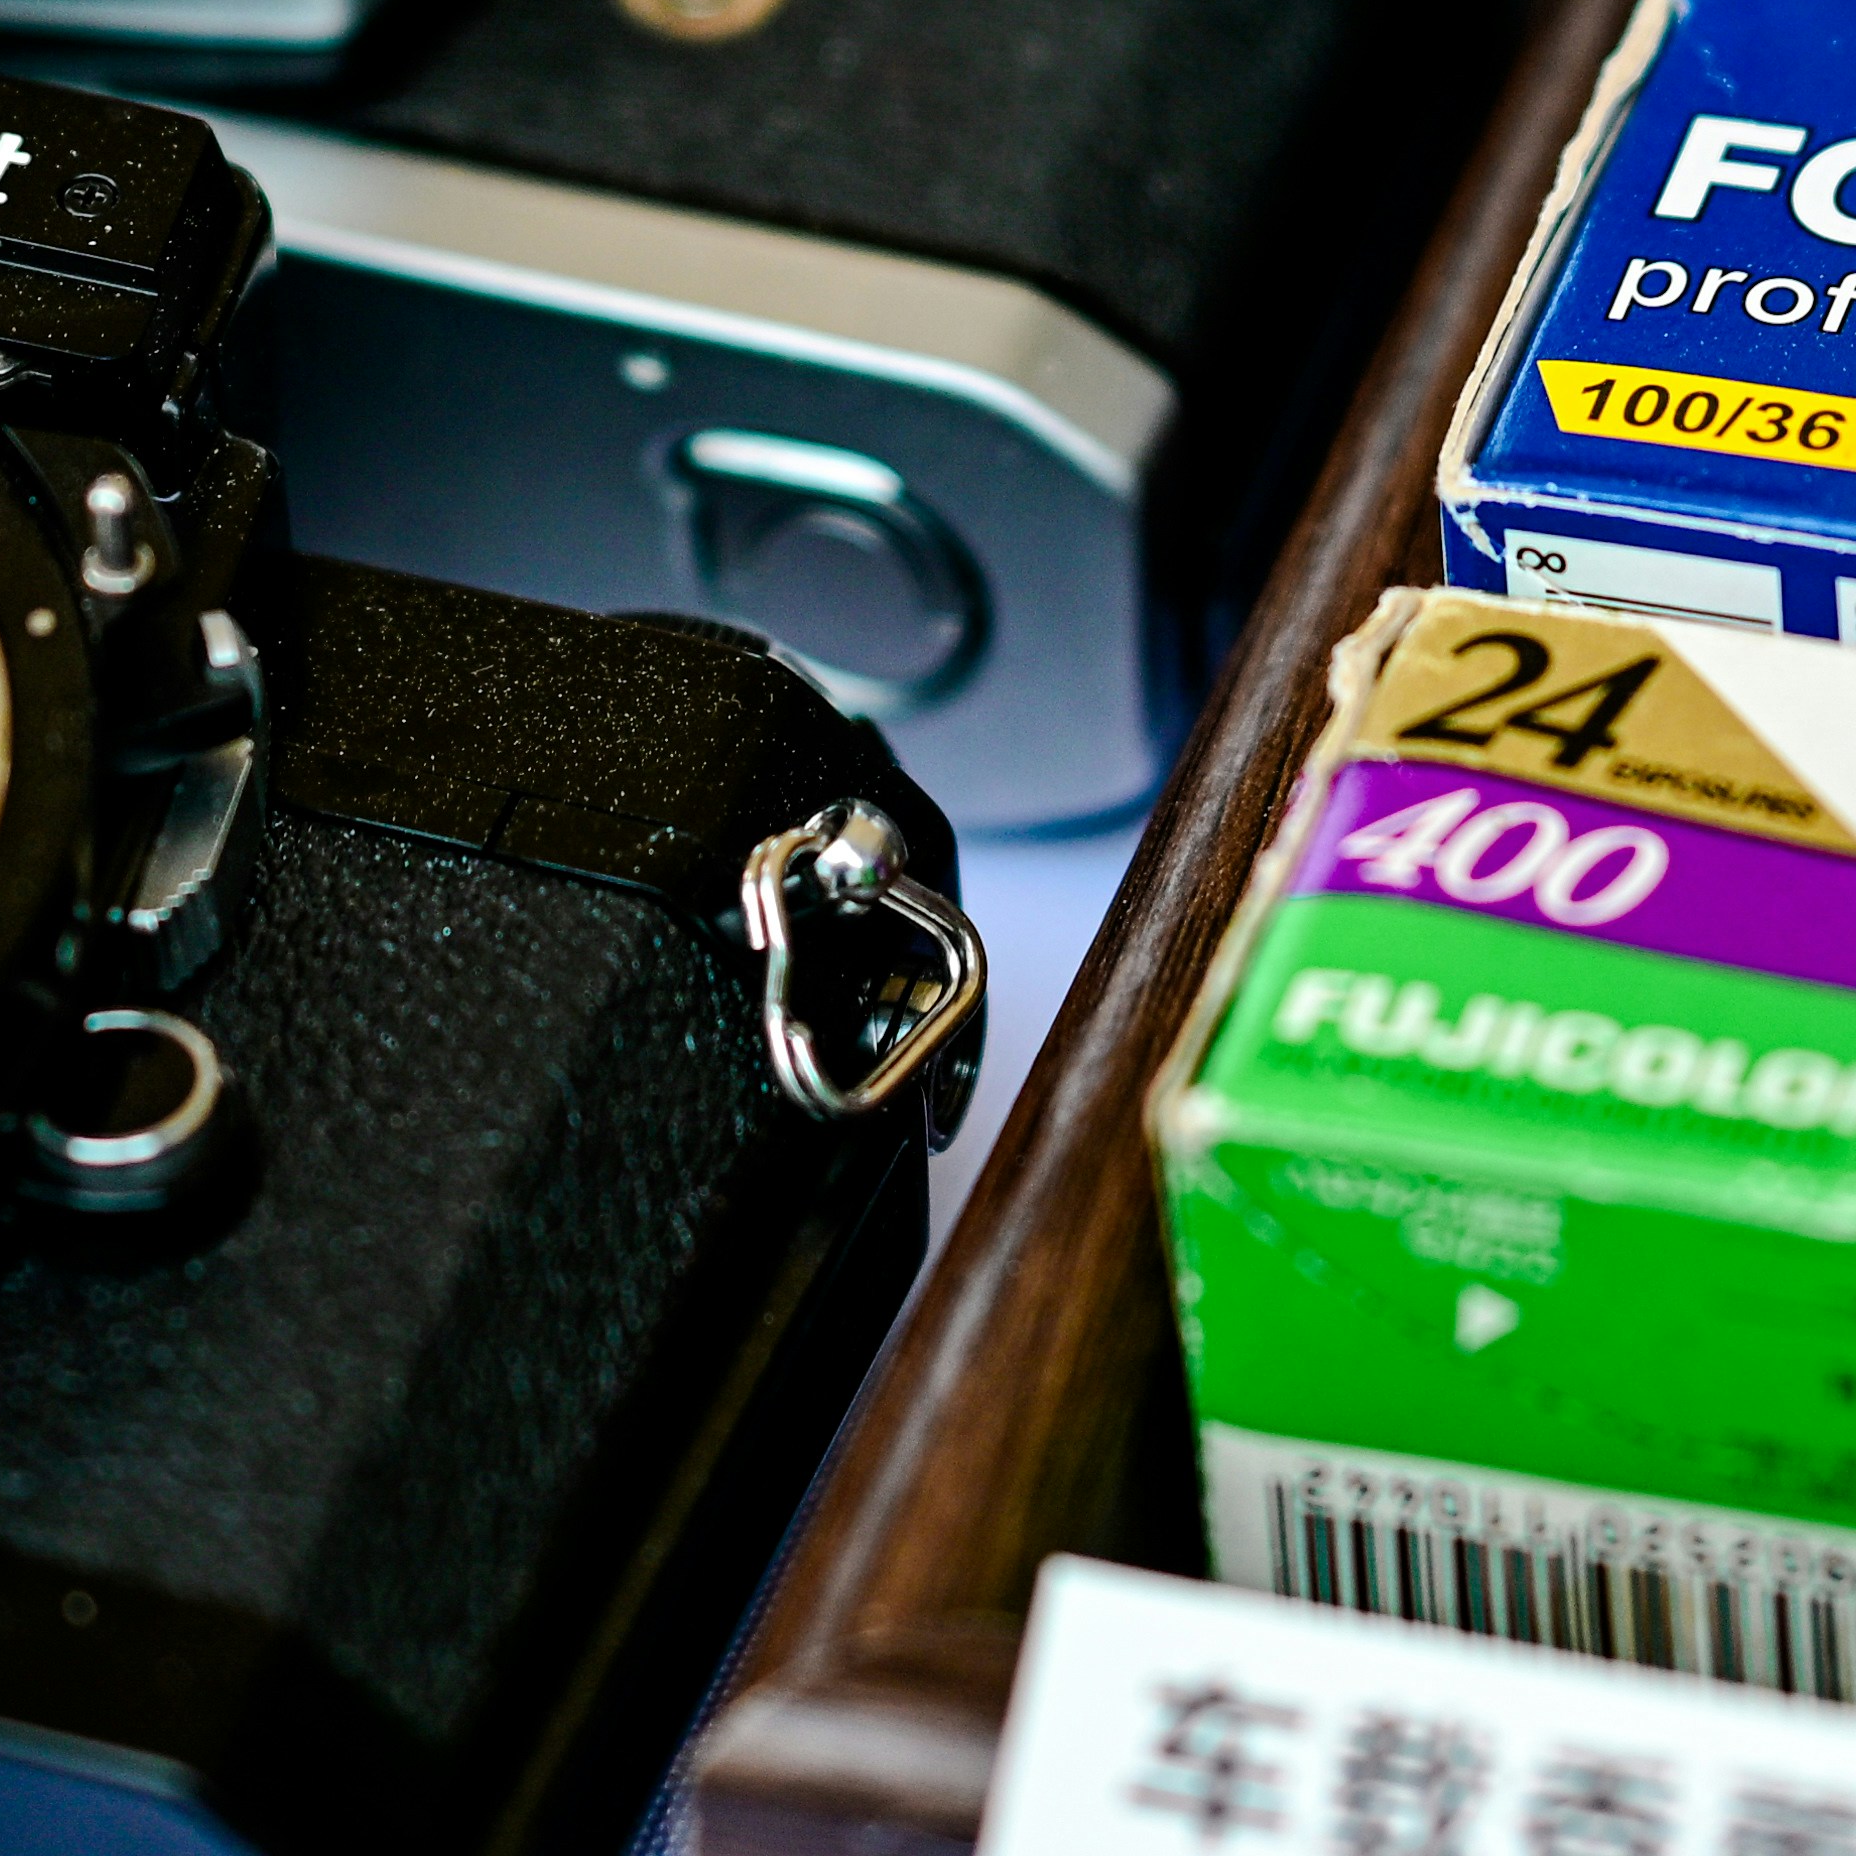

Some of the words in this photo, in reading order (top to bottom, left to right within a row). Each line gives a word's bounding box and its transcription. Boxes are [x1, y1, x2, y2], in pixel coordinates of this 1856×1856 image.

[1579, 378, 1849, 454] 100/36
[1397, 631, 1662, 769] 24
[1341, 785, 1672, 929] 400
